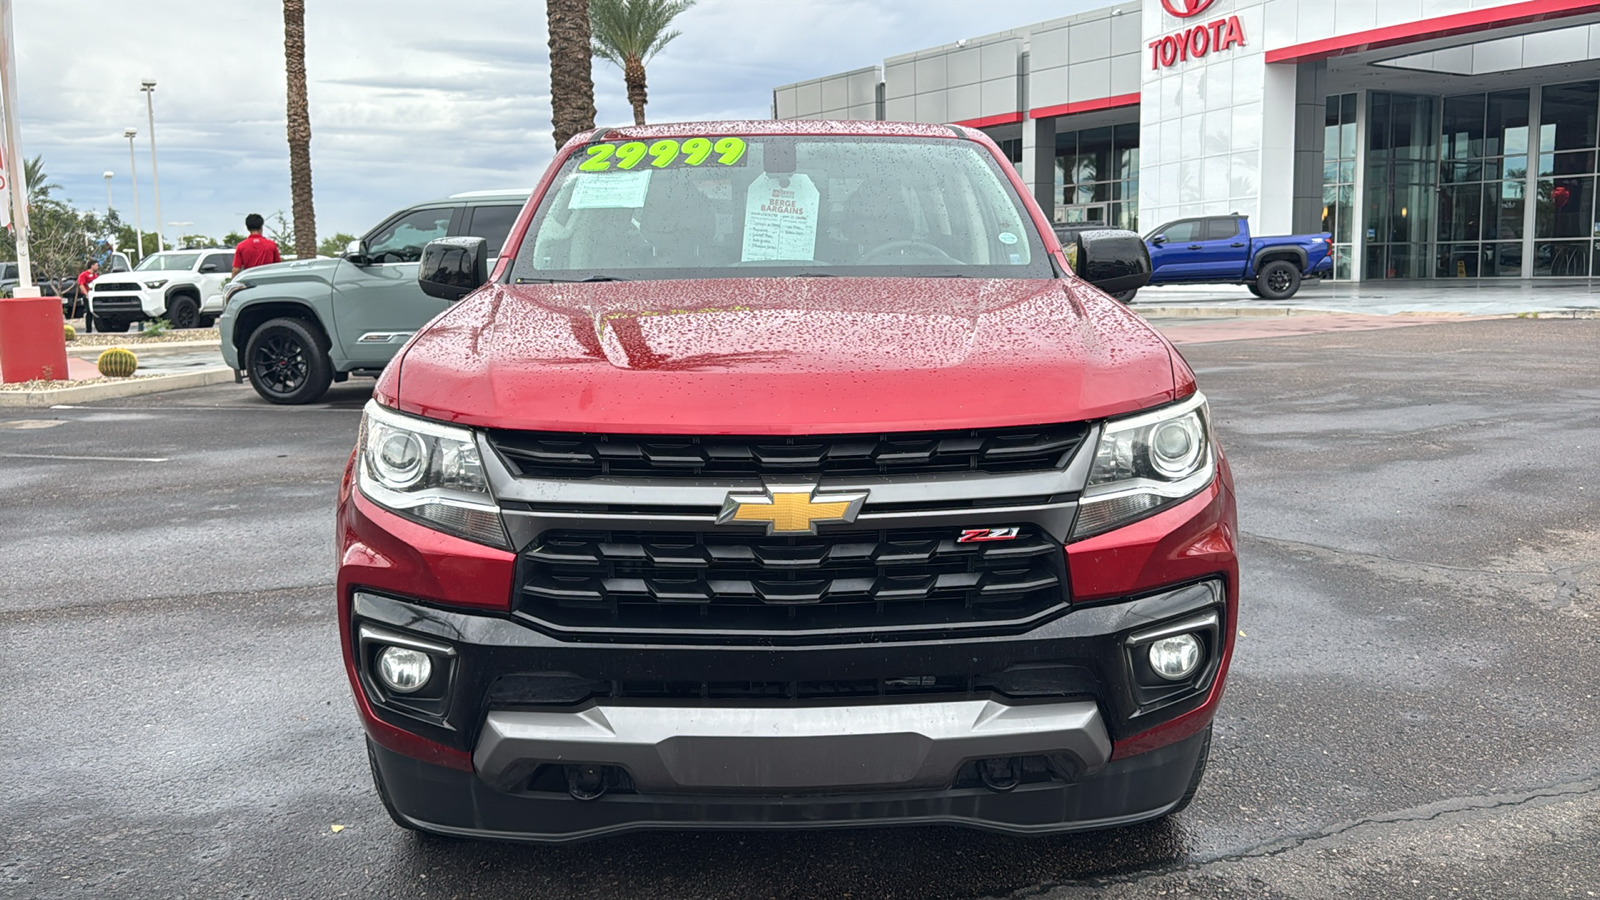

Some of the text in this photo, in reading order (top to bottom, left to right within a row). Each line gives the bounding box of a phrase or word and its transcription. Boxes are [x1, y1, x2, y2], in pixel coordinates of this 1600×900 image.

[1148, 15, 1246, 70] TOYOTA
[578, 137, 747, 171] 29999
[760, 204, 804, 215] BARGAINS
[769, 199, 796, 207] BERGE
